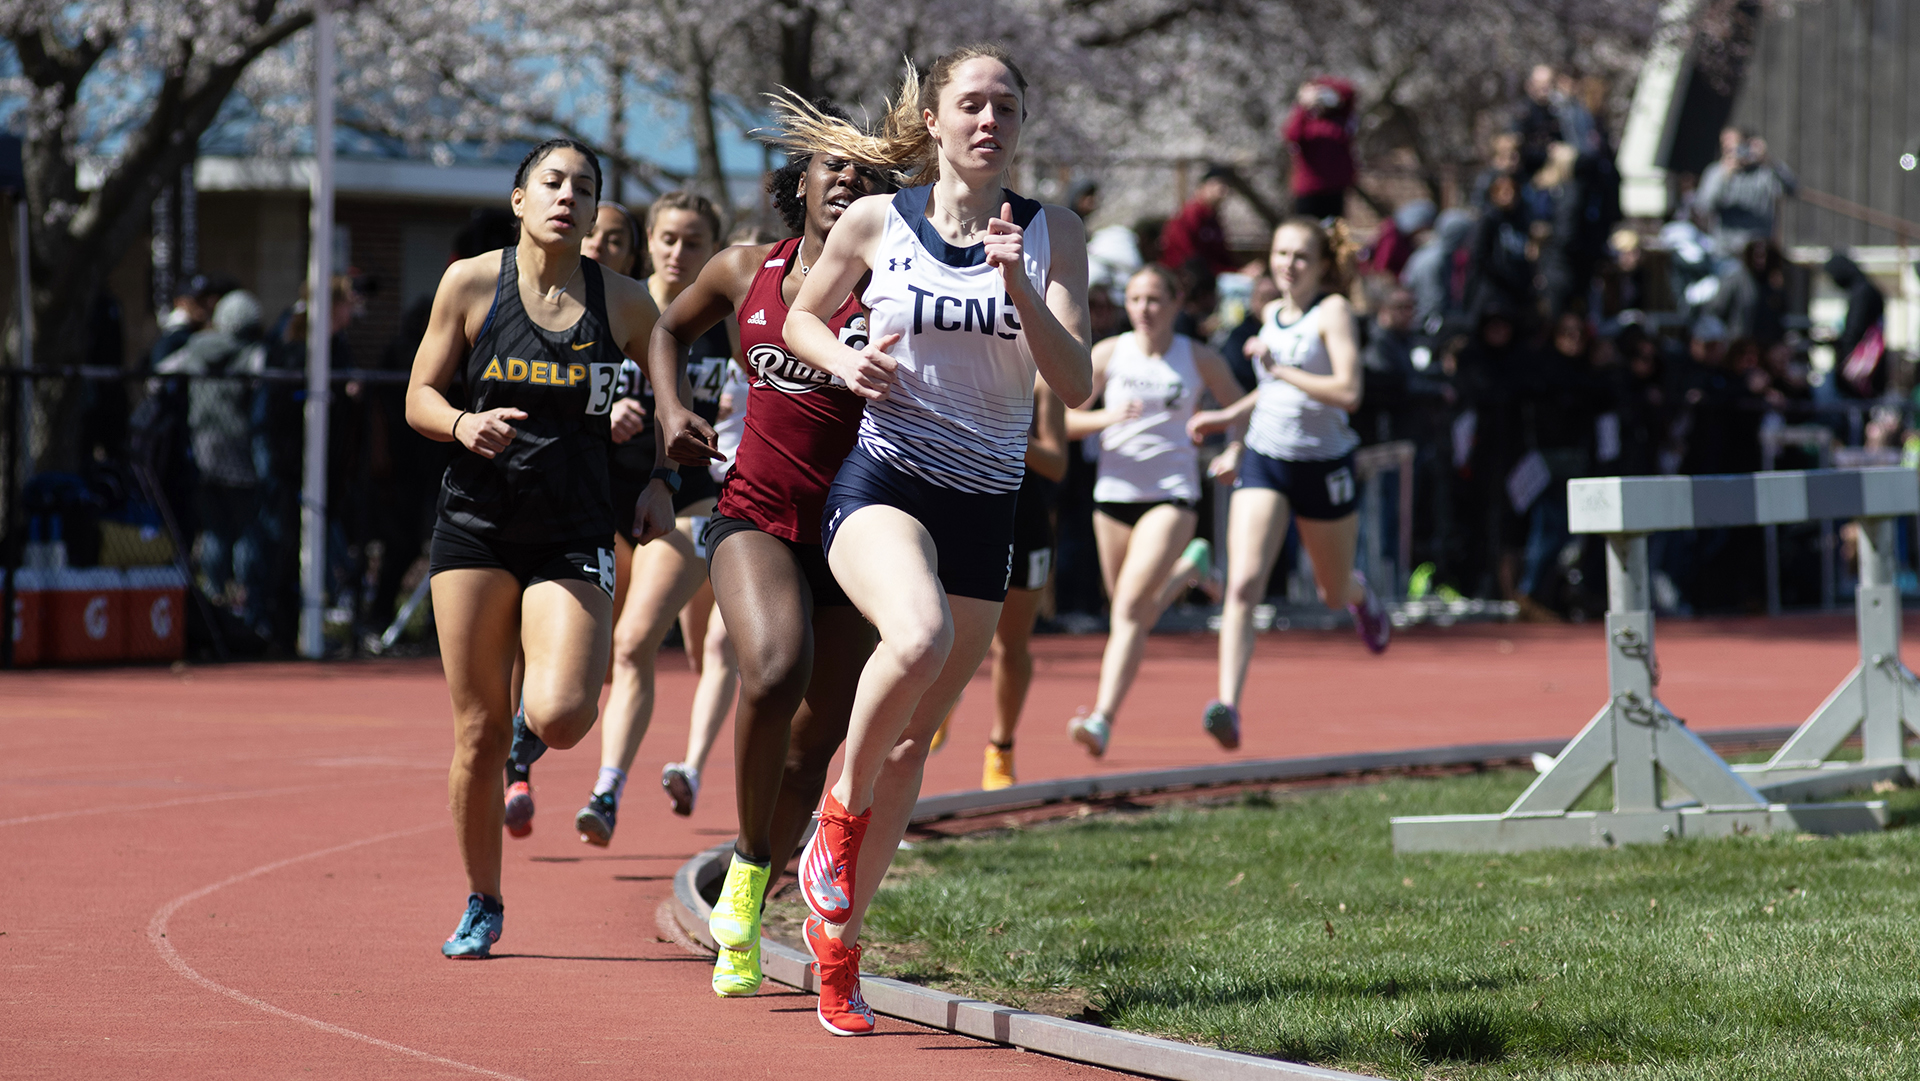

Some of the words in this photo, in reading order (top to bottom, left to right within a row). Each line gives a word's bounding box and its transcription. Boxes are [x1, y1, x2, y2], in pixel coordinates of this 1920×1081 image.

[747, 318, 767, 326] adidas
[908, 284, 1018, 340] TCN
[481, 355, 592, 388] ADELP
[594, 366, 614, 413] 3
[704, 362, 722, 396] 4
[1164, 382, 1183, 410] 2
[84, 597, 108, 640] G
[151, 597, 172, 640] G
